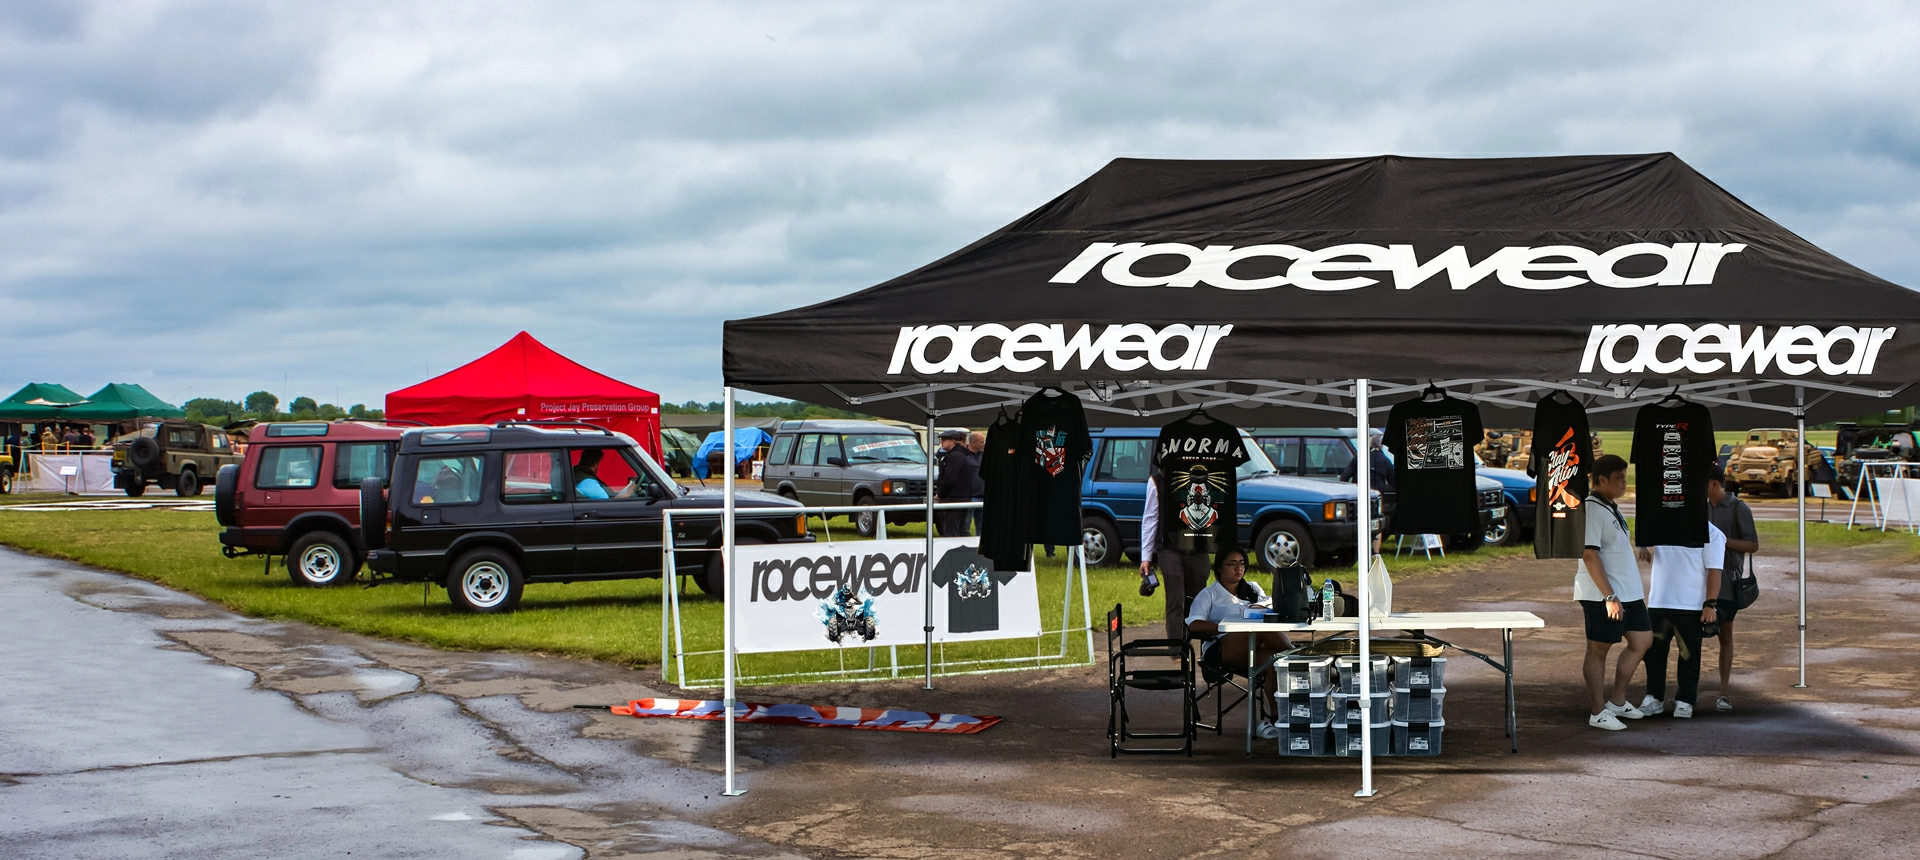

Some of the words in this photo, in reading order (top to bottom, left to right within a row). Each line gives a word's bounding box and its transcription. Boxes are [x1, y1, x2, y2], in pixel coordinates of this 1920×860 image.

[1049, 242, 1747, 292] racewear
[887, 322, 1234, 376] racewear
[1579, 322, 1896, 376] racewear
[540, 402, 567, 414] Project
[567, 403, 580, 413] Jay
[582, 402, 626, 412] Preservation
[627, 402, 650, 414] Group
[1675, 422, 1689, 430] R
[750, 552, 928, 603] racewear
